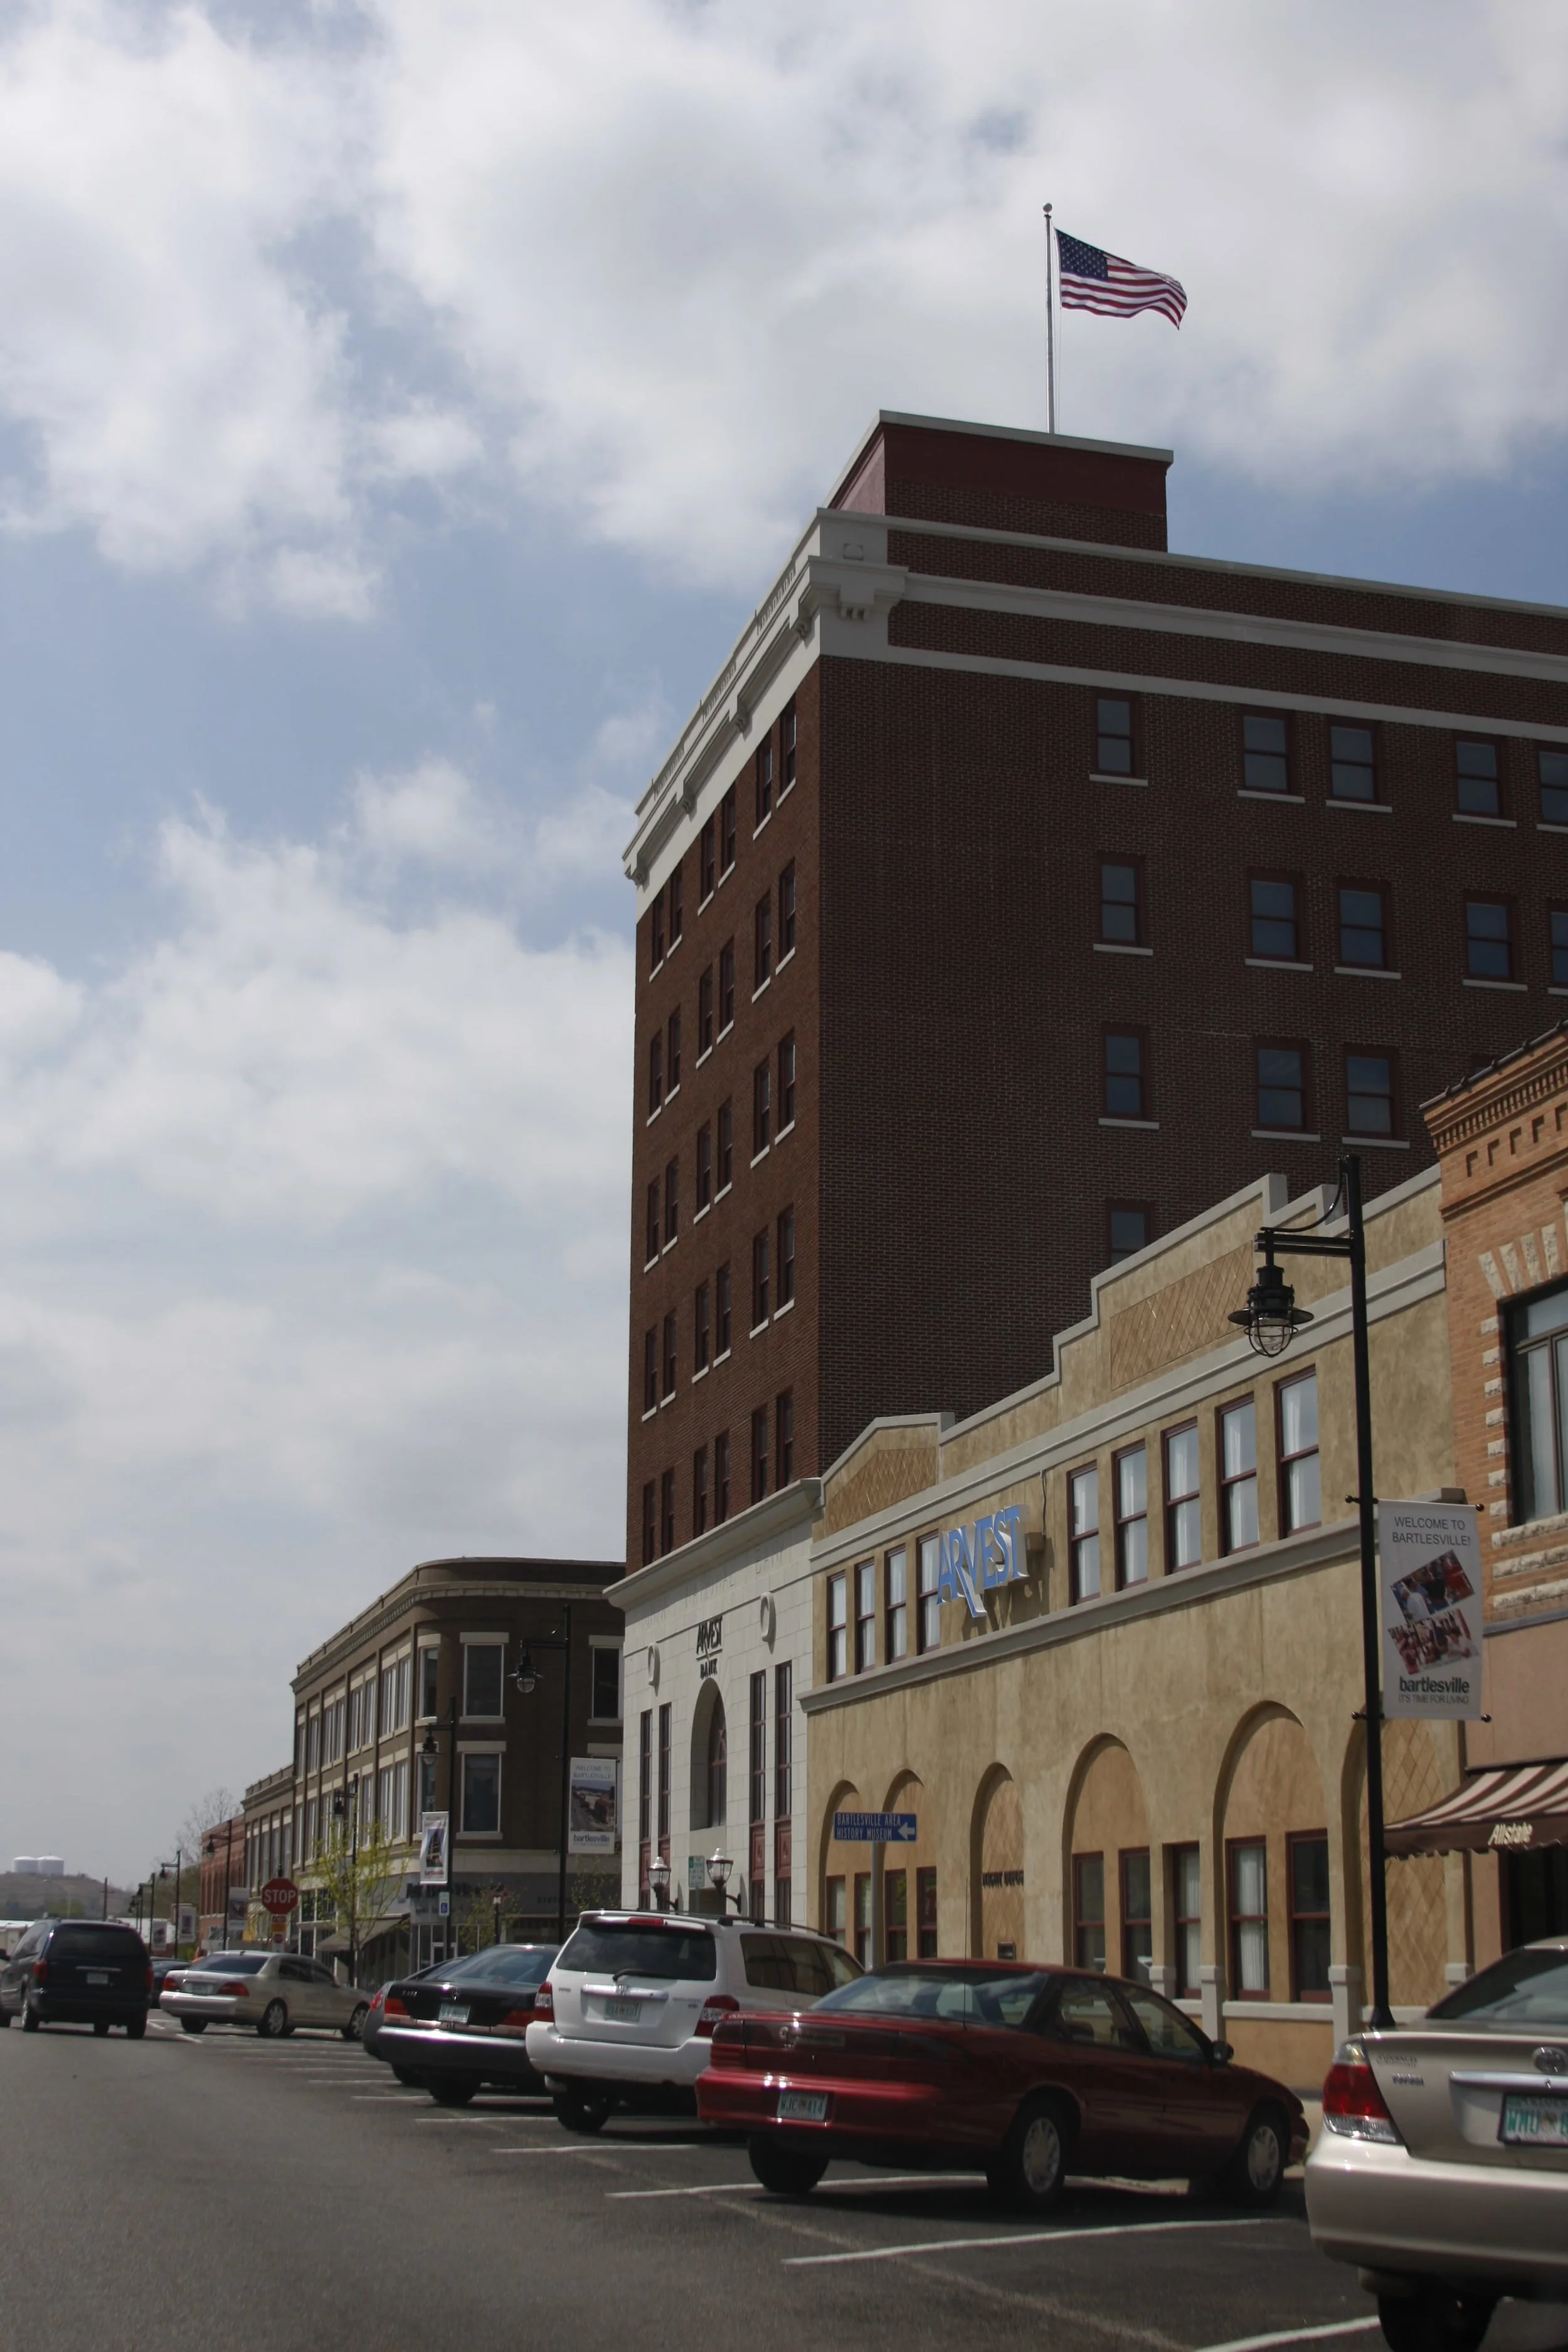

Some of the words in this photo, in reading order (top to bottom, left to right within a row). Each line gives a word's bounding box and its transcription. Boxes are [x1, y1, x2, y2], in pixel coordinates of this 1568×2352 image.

[1394, 1516, 1449, 1529] WELCOME
[1451, 1519, 1465, 1530] TO
[1392, 1532, 1471, 1546] BARTLESVILLE!
[937, 1505, 1022, 1618] ARVEST
[1399, 1675, 1470, 1693] bartlesville
[1412, 1694, 1429, 1703] TIME
[1430, 1694, 1446, 1703] FOR
[1447, 1695, 1470, 1704] LIVING
[837, 1814, 881, 1826] BARTLESVILLE
[884, 1814, 901, 1826] AREA
[573, 1834, 610, 1843] bartlesville
[837, 1827, 864, 1839] HISTORY
[867, 1827, 892, 1840] MUSEUM
[1488, 1821, 1533, 1845] Allstate
[265, 1889, 296, 1904] STOP
